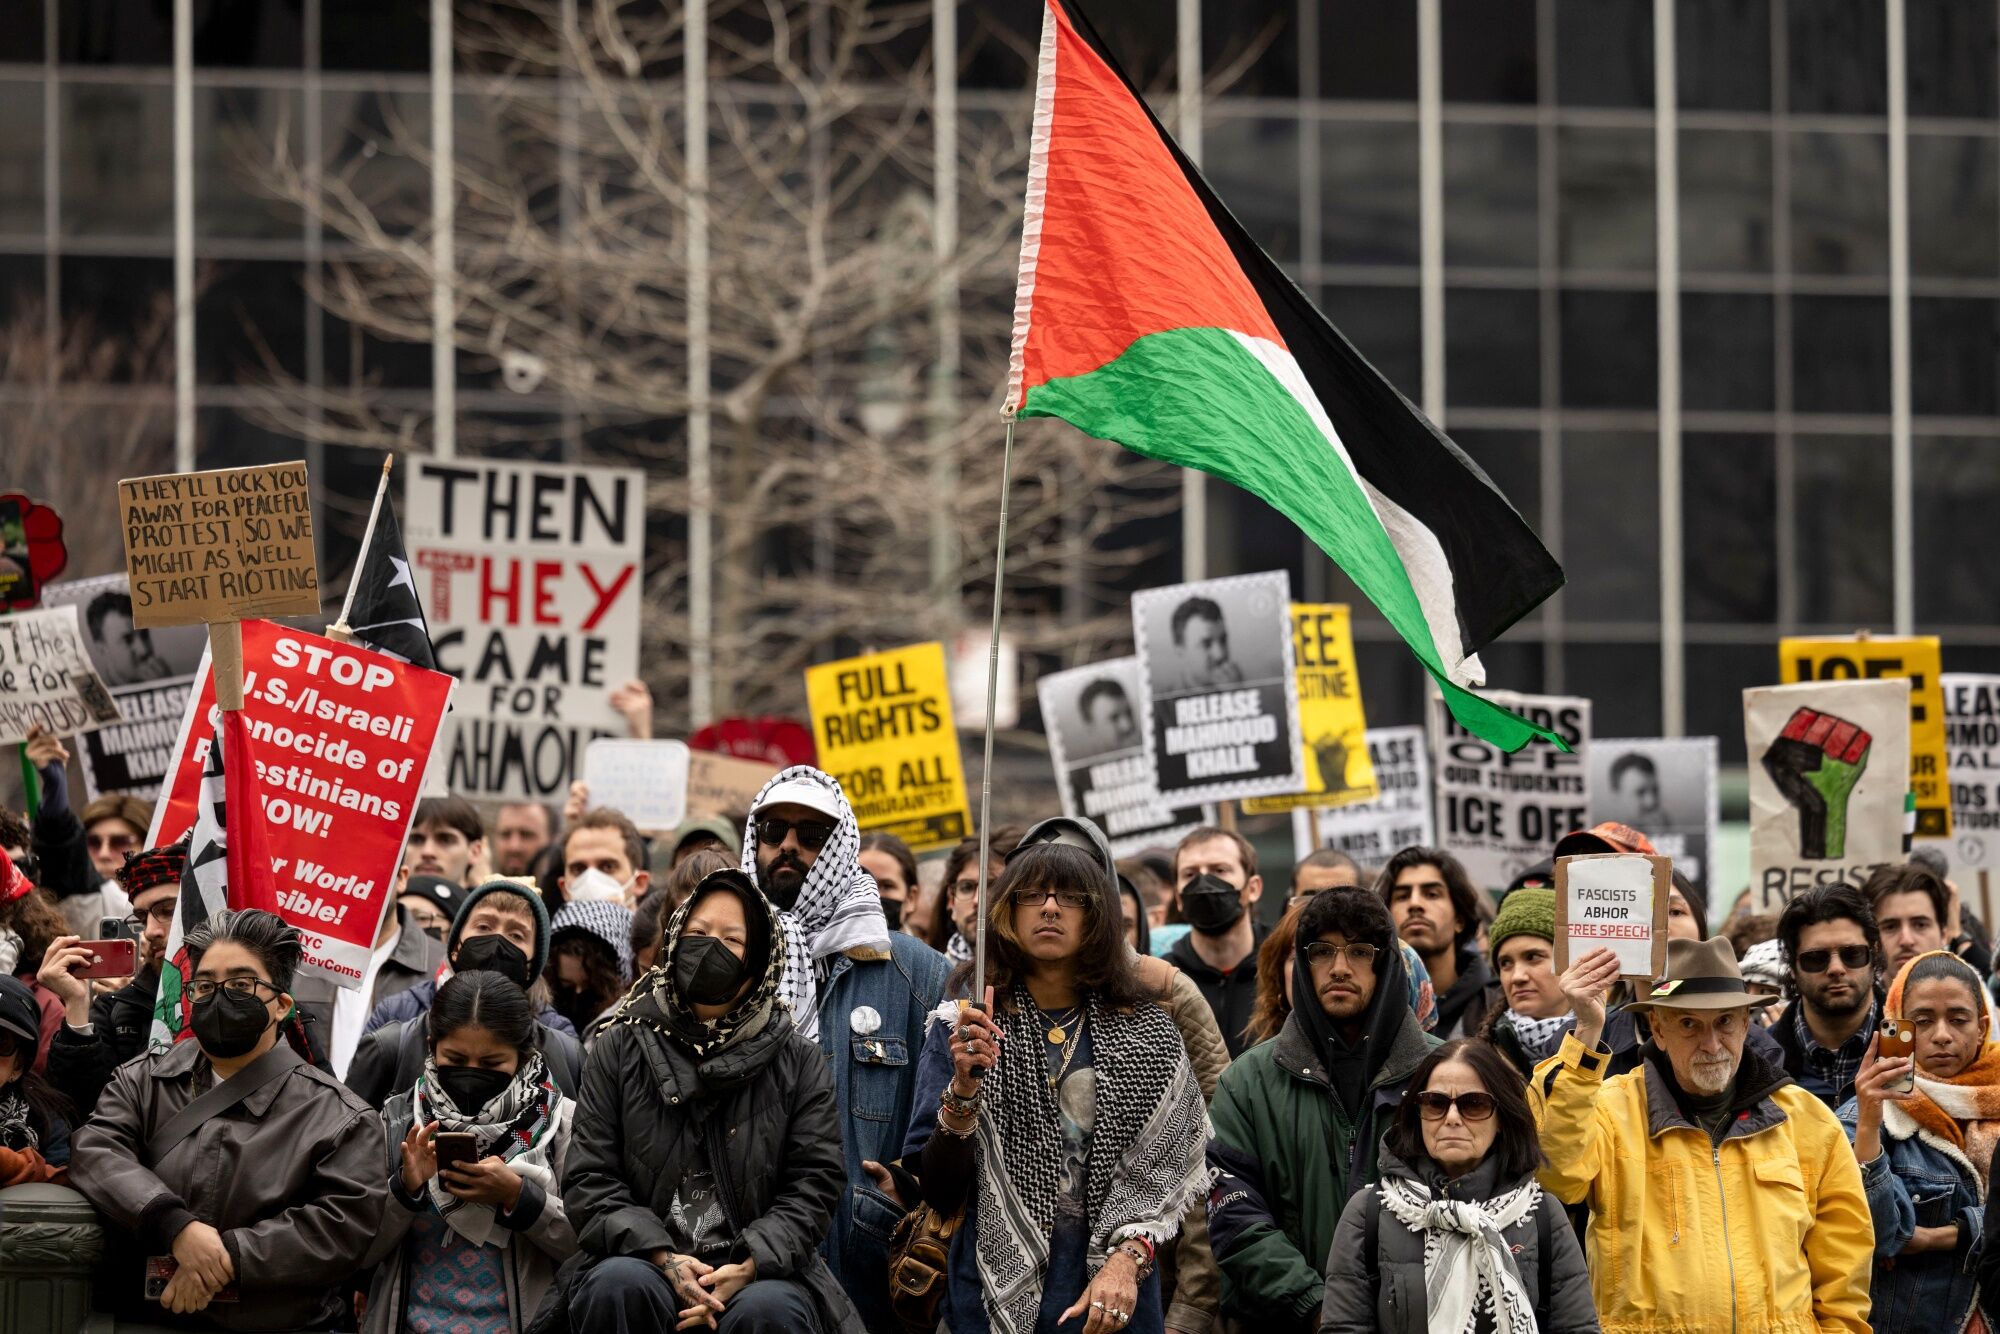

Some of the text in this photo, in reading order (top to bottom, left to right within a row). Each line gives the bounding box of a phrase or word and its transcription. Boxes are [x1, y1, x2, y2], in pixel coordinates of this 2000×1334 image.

[121, 470, 307, 500] THEY'LL LOCK YOU
[128, 502, 184, 525] AWAY
[192, 499, 230, 518] FOR
[421, 464, 628, 546] THEN
[128, 515, 312, 549] PROTEST, SO WE
[131, 545, 301, 576] MIGHT AS WELL
[136, 567, 318, 607] START RIOTING
[417, 548, 637, 632] THEY
[28, 618, 81, 663] they
[432, 628, 607, 687] CAME
[1292, 613, 1338, 667] EE
[29, 663, 70, 695] for
[271, 637, 395, 693] STOP
[836, 662, 916, 706] FULL
[1300, 670, 1351, 701] STINE
[489, 685, 563, 721] FOR
[1174, 689, 1262, 727] RELEASE
[823, 697, 941, 751] RIGHTS
[1165, 715, 1278, 756] MAHMOUD
[377, 757, 415, 785] of
[447, 719, 618, 796] AHMO
[898, 756, 953, 790] ALL
[1185, 746, 1261, 779] KHALIL
[1911, 754, 1936, 775] UR
[192, 737, 400, 821] Pestinians
[1445, 766, 1584, 794] OUR STUDENTS
[261, 793, 333, 839] OW!
[1447, 795, 1504, 839] ICE
[1520, 803, 1585, 843] OFF
[294, 859, 375, 901] World
[1578, 888, 1637, 902] FASCISTS
[276, 890, 348, 926] sible!
[1584, 907, 1629, 919] ABHOR
[1567, 923, 1650, 938] FREE SPEECH
[300, 952, 362, 979] RevComs
[692, 1189, 708, 1200] OF
[1213, 1190, 1248, 1214] LAUREN
